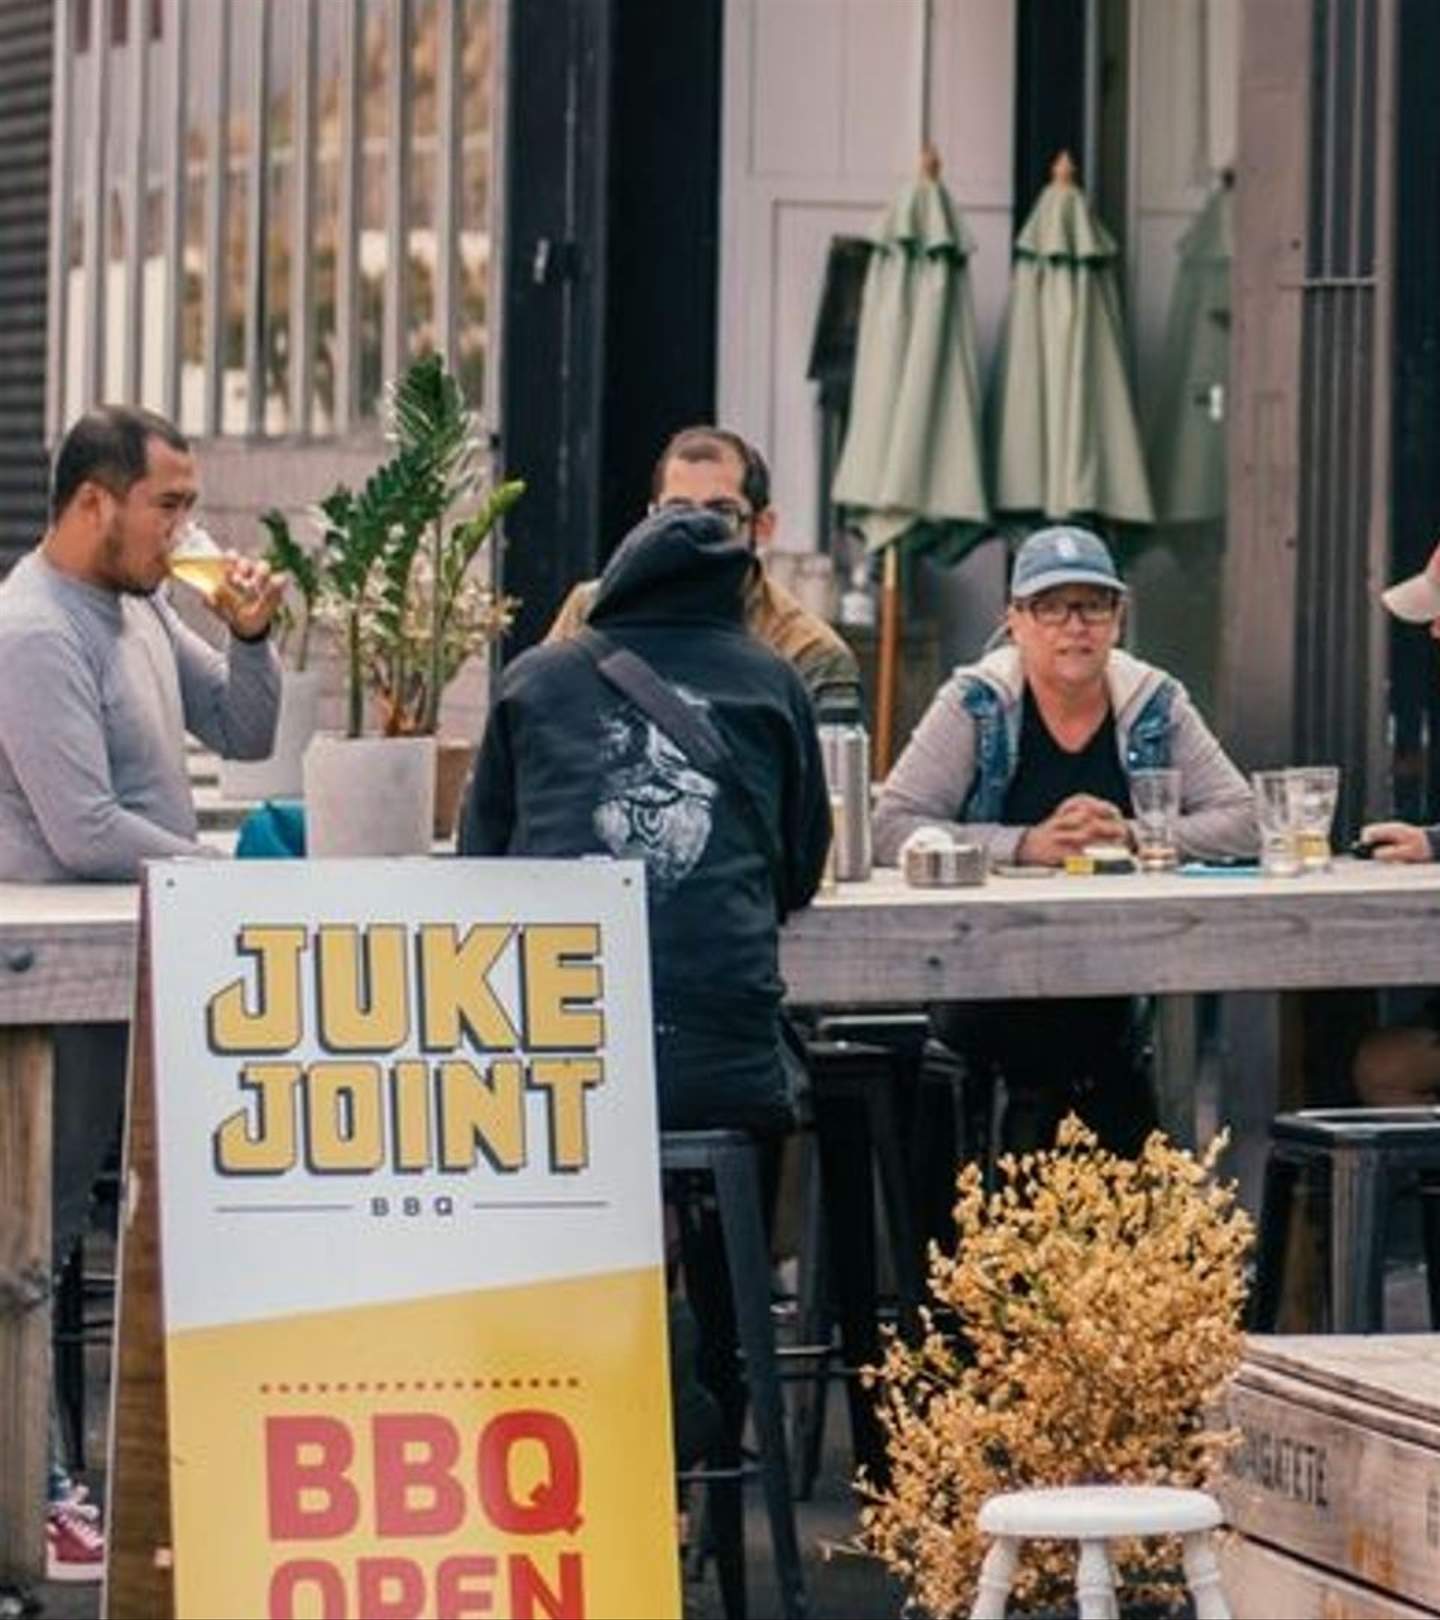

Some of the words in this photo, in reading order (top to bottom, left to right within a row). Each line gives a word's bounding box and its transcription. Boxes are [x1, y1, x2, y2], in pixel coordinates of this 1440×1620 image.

[206, 922, 606, 1055] JUKE
[213, 1057, 606, 1176] JOINT
[370, 1196, 455, 1218] BBQ
[264, 1408, 585, 1543] BBQ
[268, 1552, 586, 1620] OPEN
